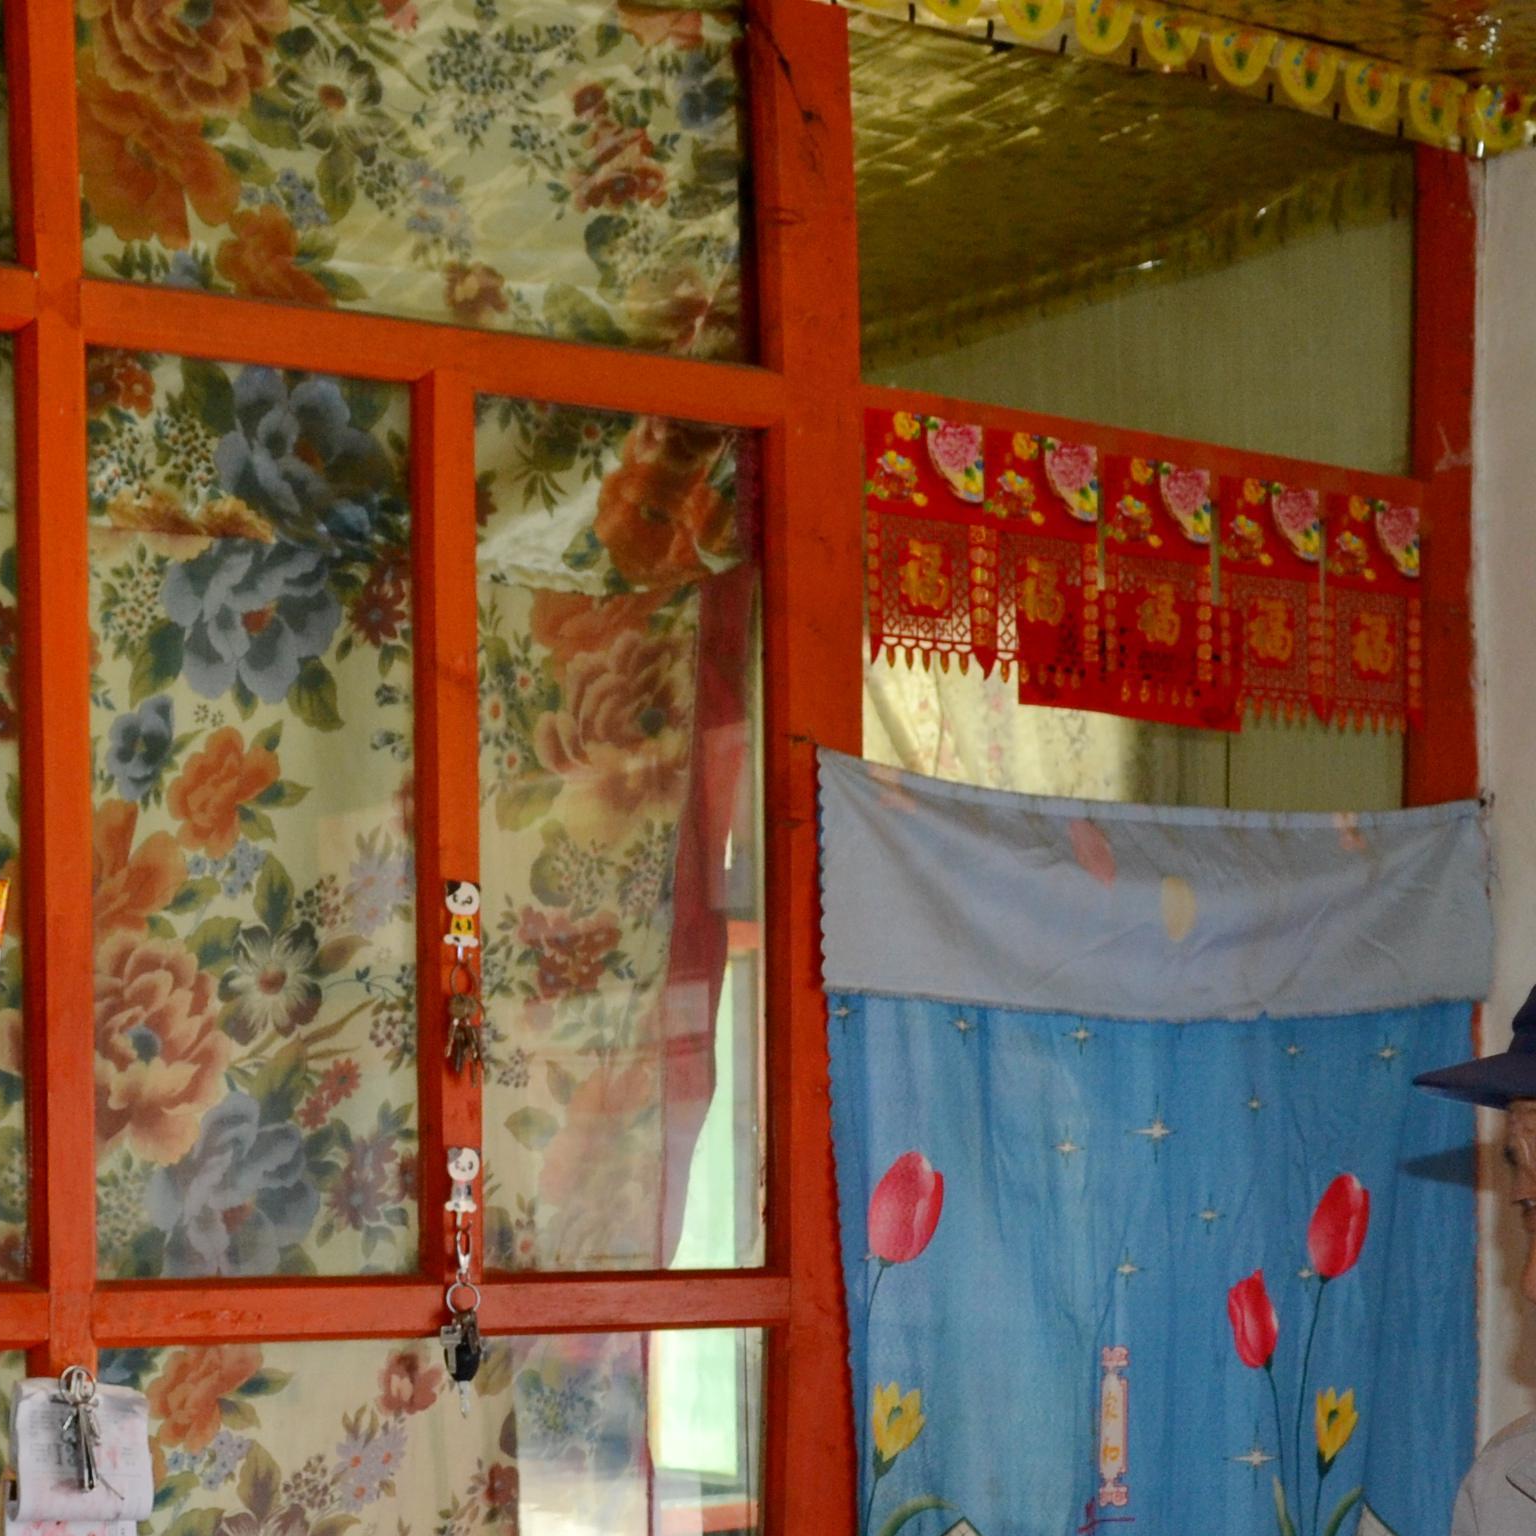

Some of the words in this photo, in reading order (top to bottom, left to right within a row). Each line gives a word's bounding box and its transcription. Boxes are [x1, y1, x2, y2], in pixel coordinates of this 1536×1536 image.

[900, 538, 950, 610] 福
[1017, 556, 1064, 626] 福
[1136, 581, 1182, 647] 福
